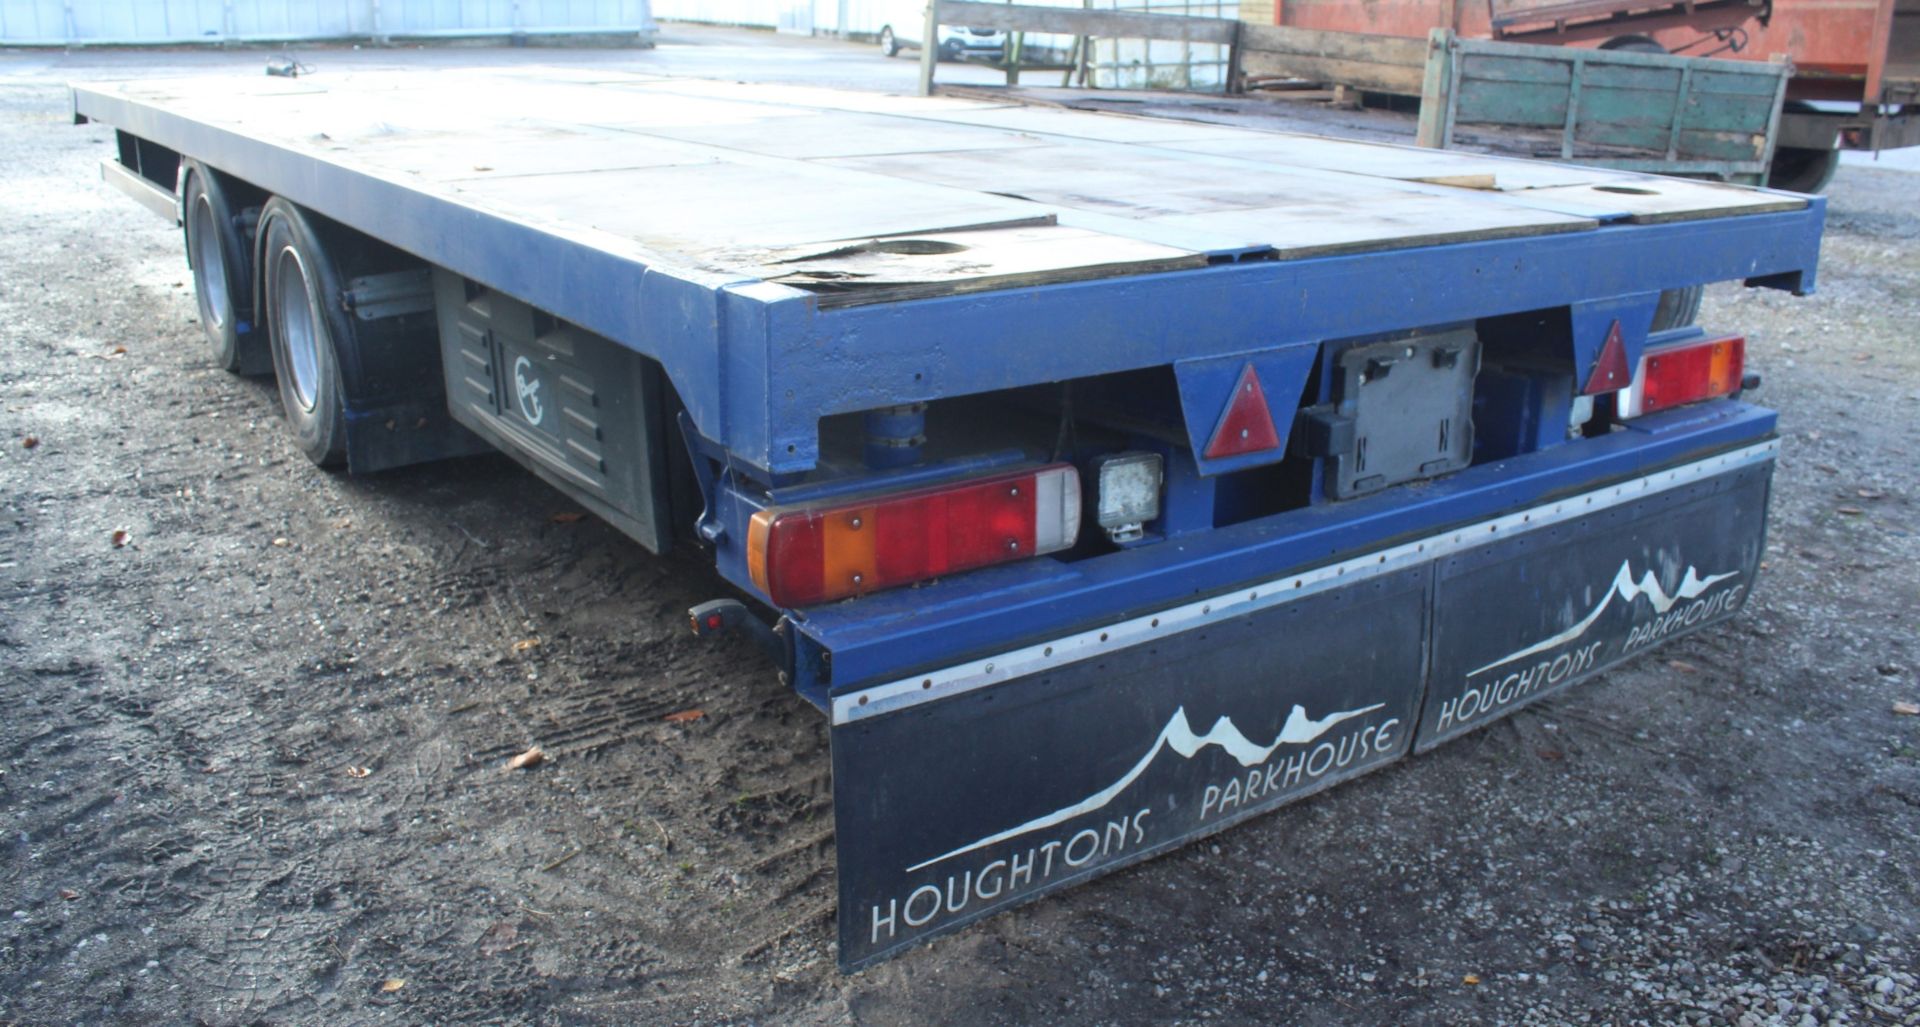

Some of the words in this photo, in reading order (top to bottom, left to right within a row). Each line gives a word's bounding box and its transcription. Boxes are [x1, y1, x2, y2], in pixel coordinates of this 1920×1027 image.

[1436, 641, 1602, 733] HOUGHTONS
[1622, 584, 1745, 654] PARKHOUSE
[870, 807, 1151, 944] HOUGHTONS
[1199, 717, 1400, 821] PARKHOUSE
